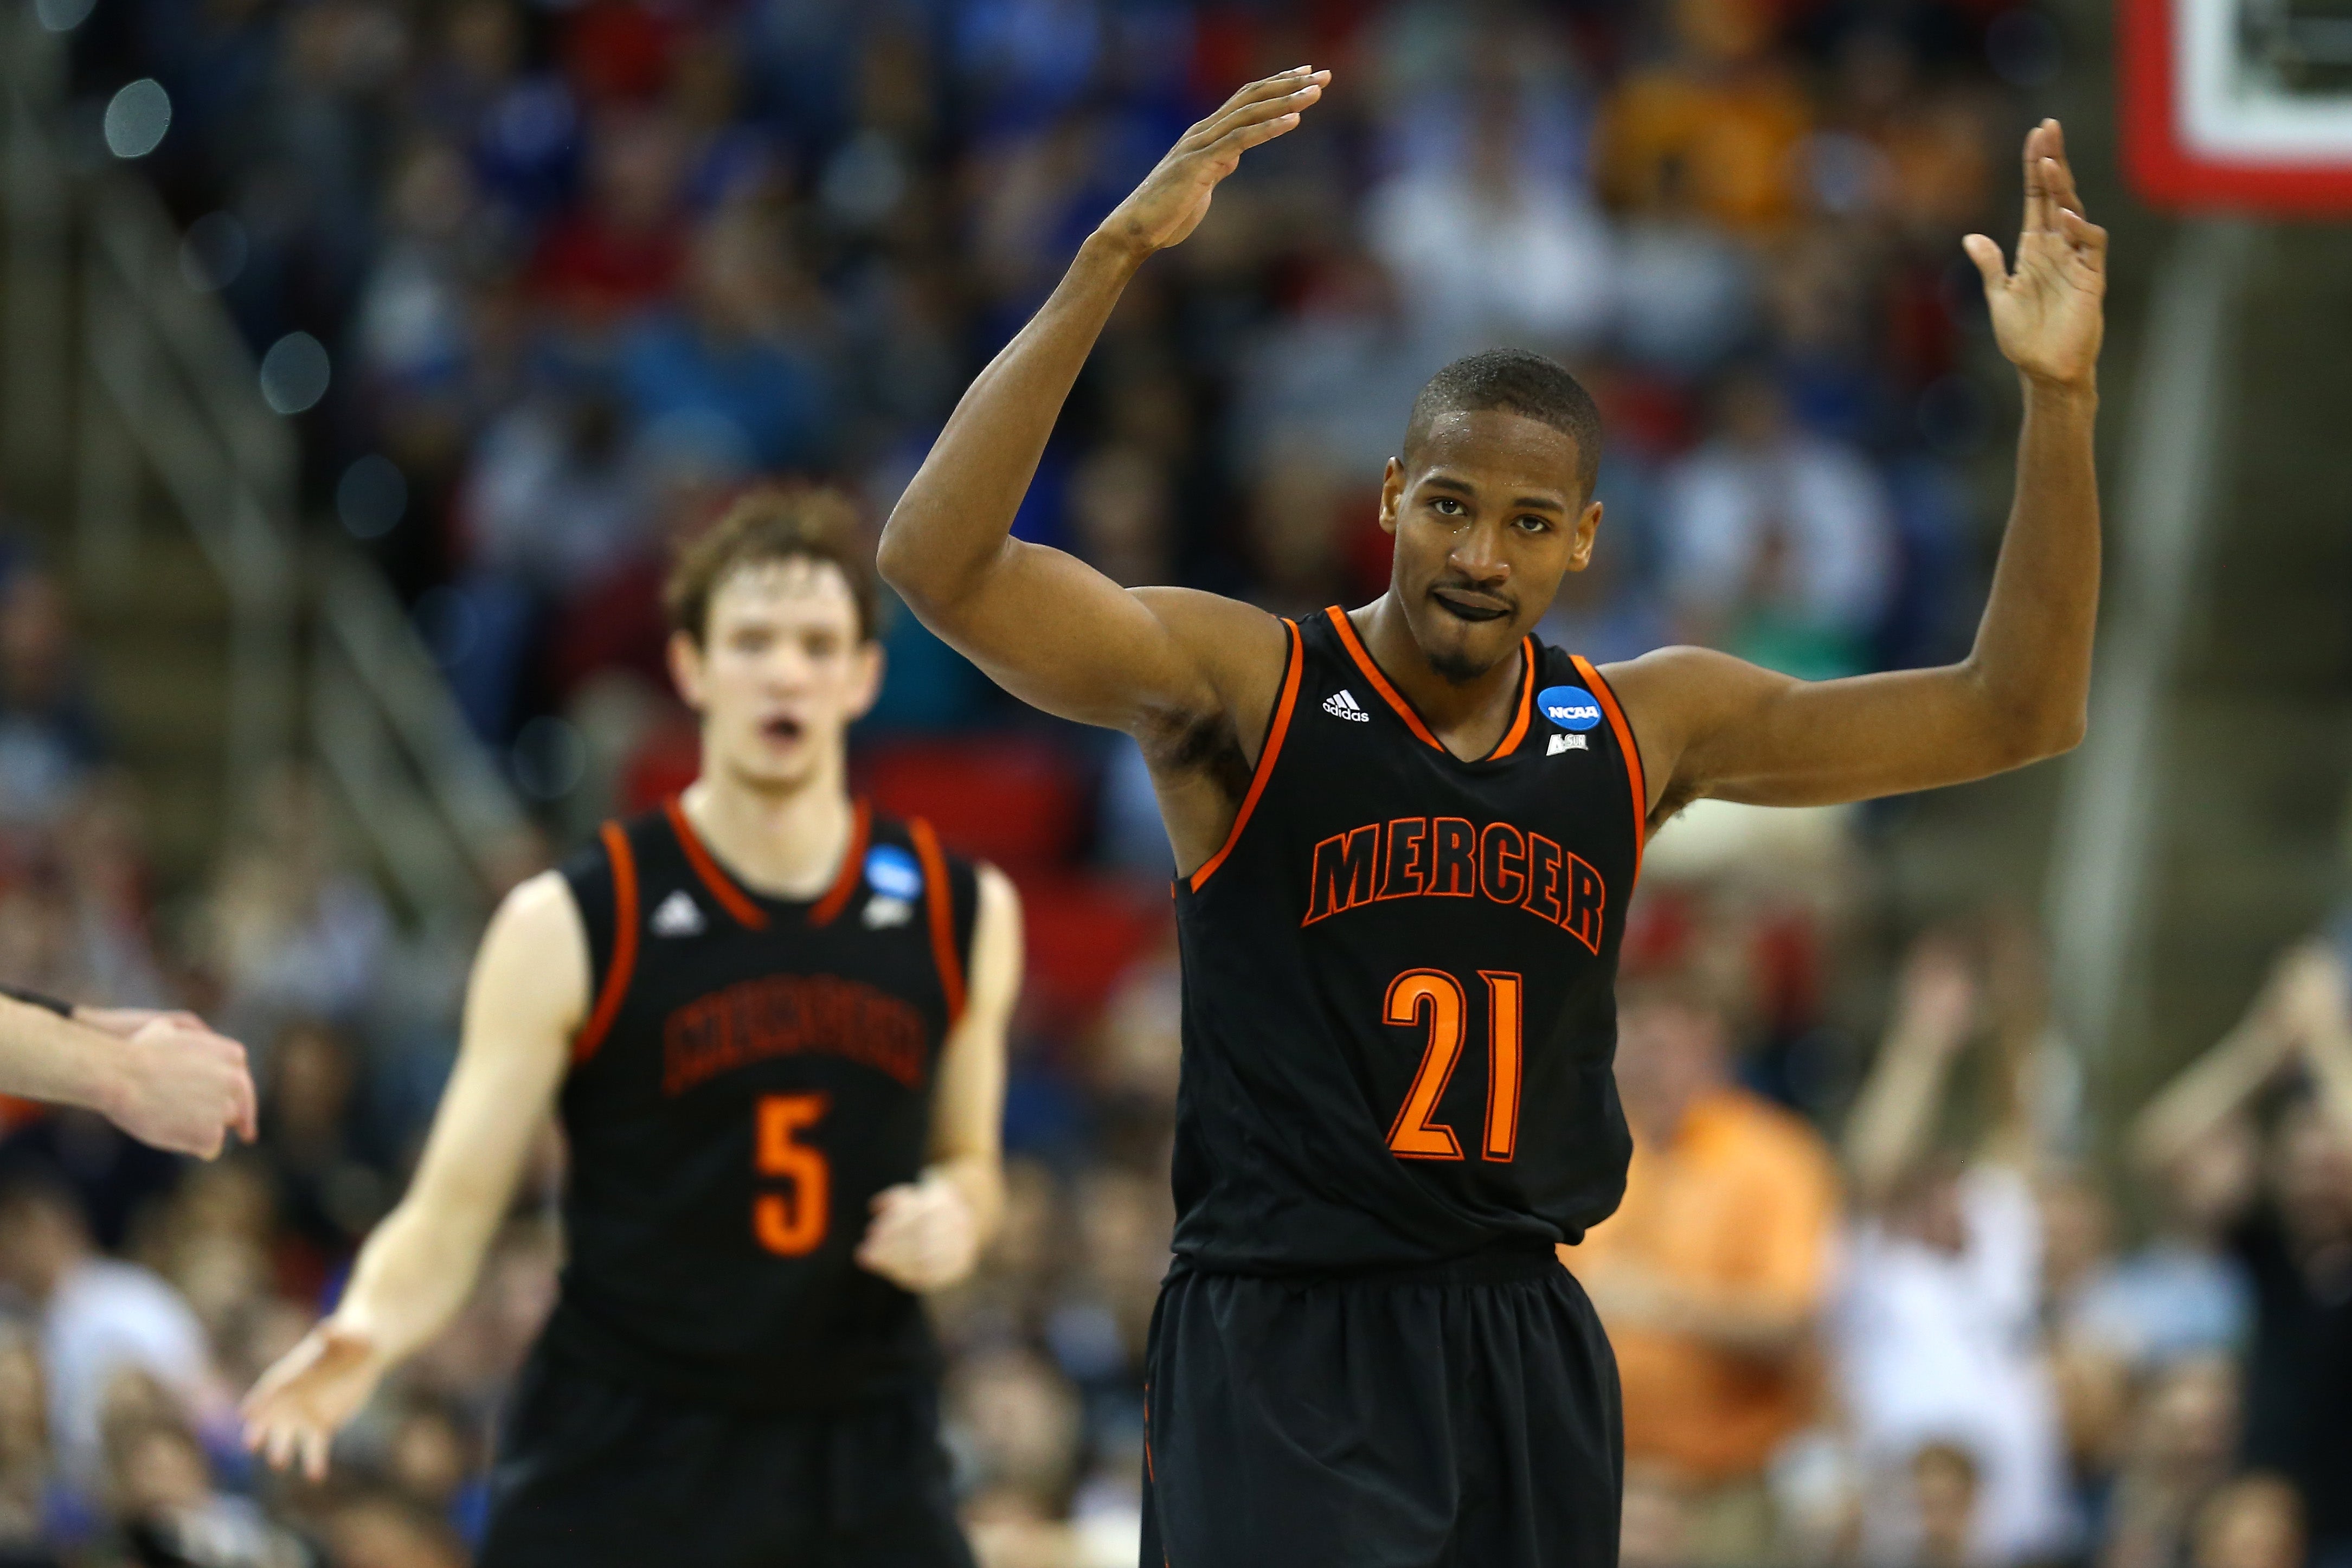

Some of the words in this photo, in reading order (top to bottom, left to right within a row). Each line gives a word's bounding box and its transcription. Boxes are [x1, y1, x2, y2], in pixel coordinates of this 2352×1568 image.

[1322, 702, 1369, 722] adidas
[1548, 706, 1598, 719] NCAA
[1301, 817, 1606, 955] MERCER
[1382, 968, 1521, 1162] 21
[755, 1093, 830, 1257] 5
